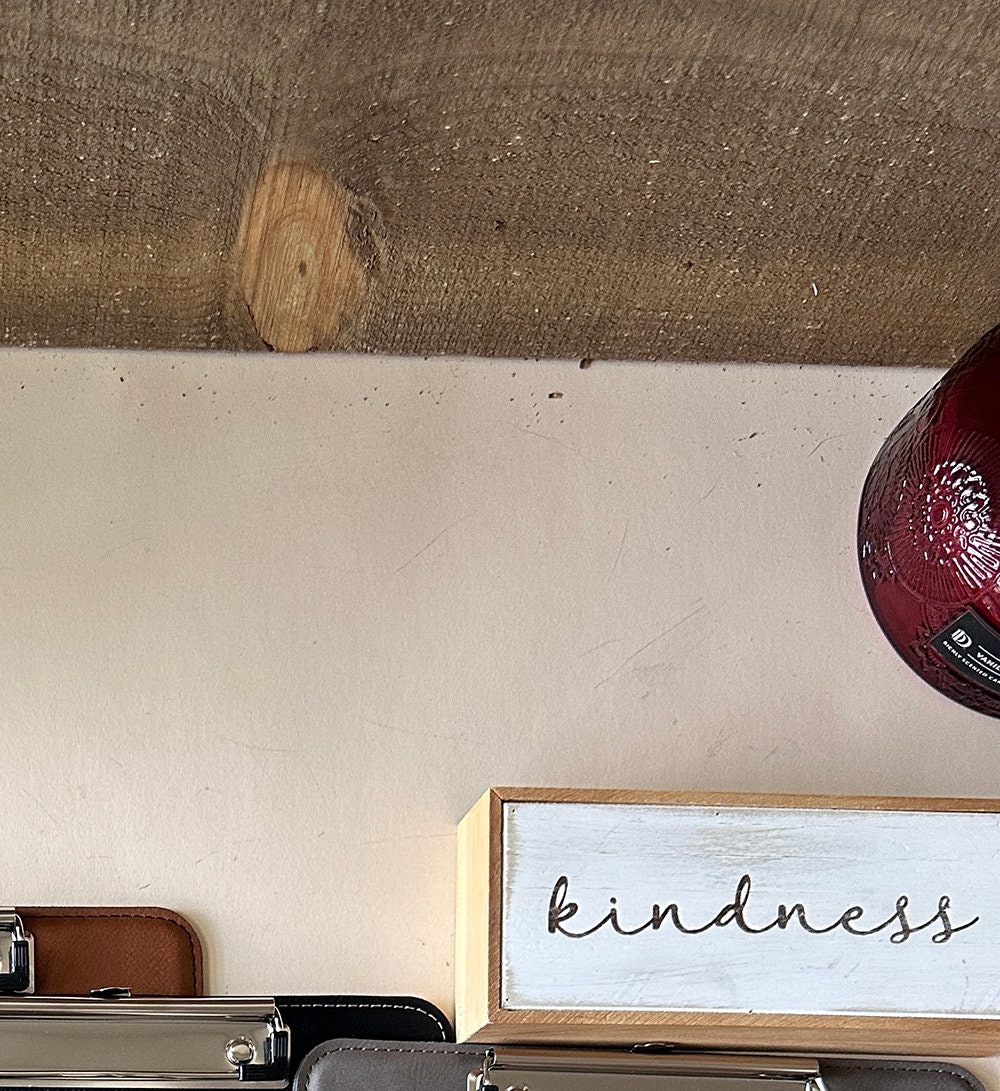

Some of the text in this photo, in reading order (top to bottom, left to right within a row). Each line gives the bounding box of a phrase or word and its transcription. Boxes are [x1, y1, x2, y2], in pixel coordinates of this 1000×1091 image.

[943, 640, 963, 659] RICHLY
[961, 657, 988, 678] SCENTED
[547, 873, 980, 945] kindness
